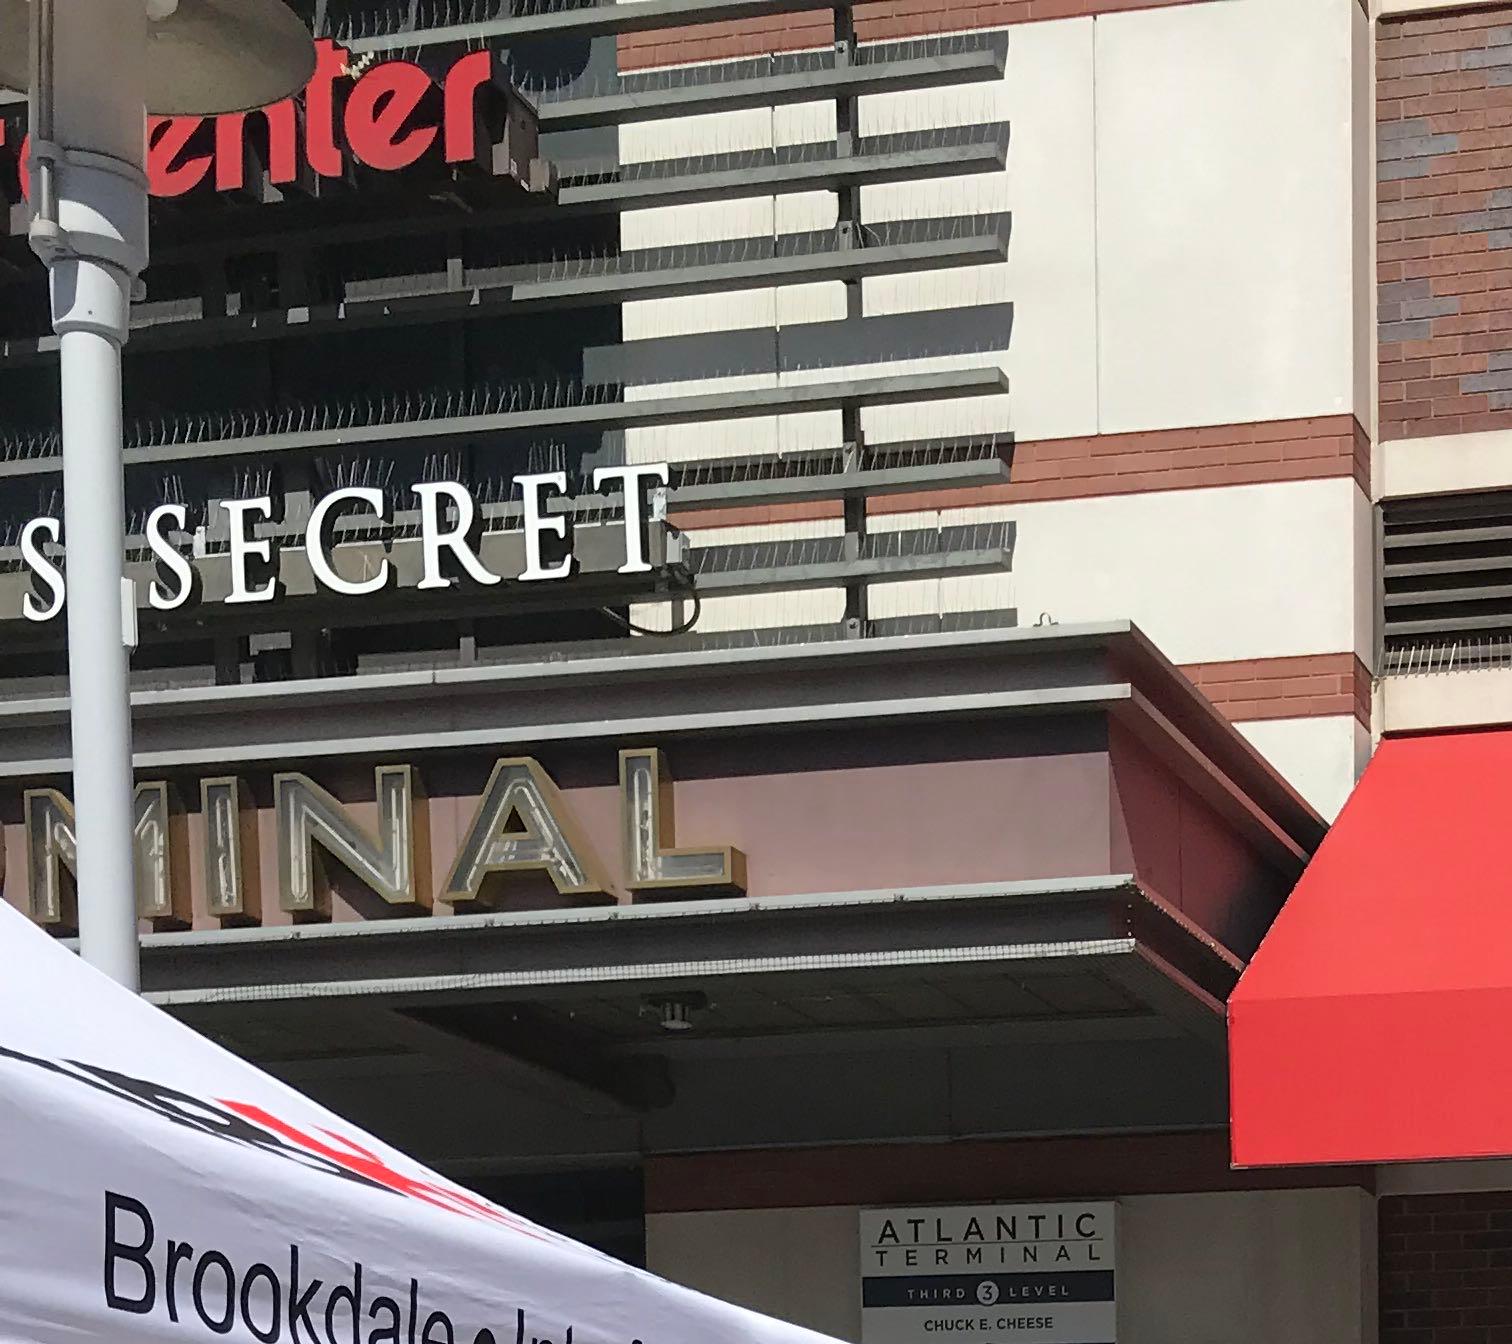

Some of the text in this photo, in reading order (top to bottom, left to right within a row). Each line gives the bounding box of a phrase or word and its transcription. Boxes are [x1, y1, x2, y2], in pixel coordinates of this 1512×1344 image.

[18, 37, 492, 201] enter
[148, 461, 671, 612] SECRET
[878, 1213, 1096, 1244] ATLANTIC
[876, 1244, 1100, 1267] TERMINAL
[907, 1285, 1069, 1300] THIRD 3 LEVEL
[924, 1317, 1053, 1332] CHUCK E. CHEESE
